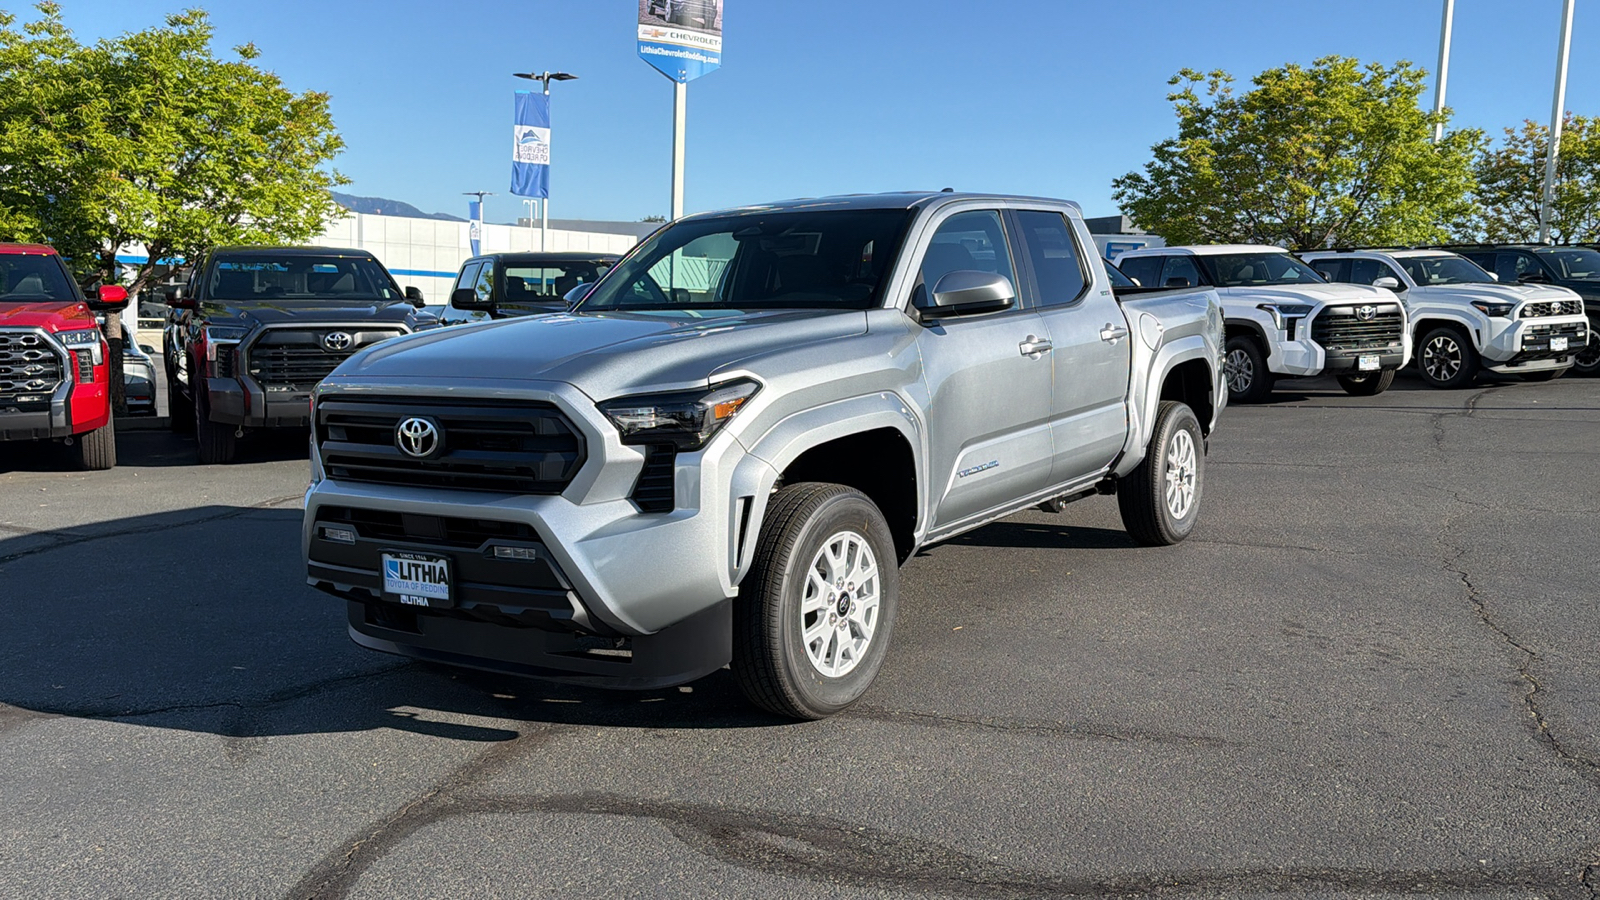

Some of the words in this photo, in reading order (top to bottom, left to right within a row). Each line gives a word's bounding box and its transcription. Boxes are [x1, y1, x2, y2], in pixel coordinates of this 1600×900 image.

[670, 31, 718, 45] CHEVROLET
[640, 45, 719, 64] LithiaChevroletRedding.com
[400, 561, 448, 585] LITHIA
[387, 579, 409, 590] TOYOTA
[410, 582, 419, 590] OF
[407, 595, 429, 607] LITHIA
